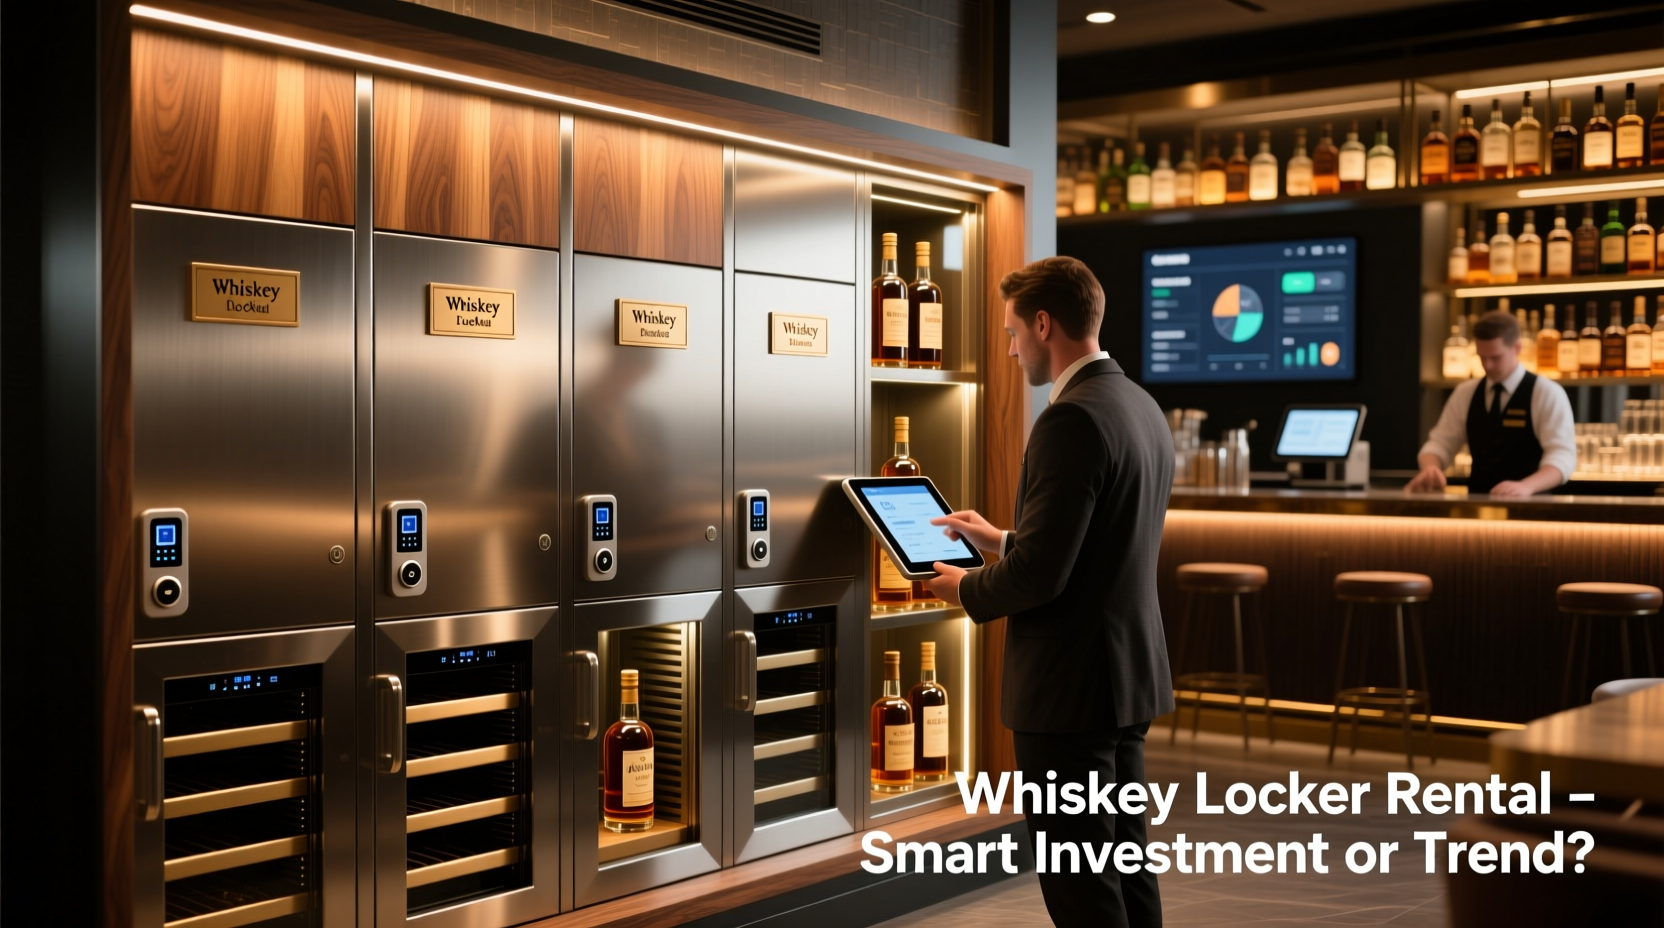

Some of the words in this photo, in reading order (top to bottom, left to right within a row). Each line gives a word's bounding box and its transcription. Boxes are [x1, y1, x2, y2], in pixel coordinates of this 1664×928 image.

[212, 278, 280, 303] Whiskey
[446, 296, 500, 318] Whiskey
[632, 309, 677, 330] Whiskey
